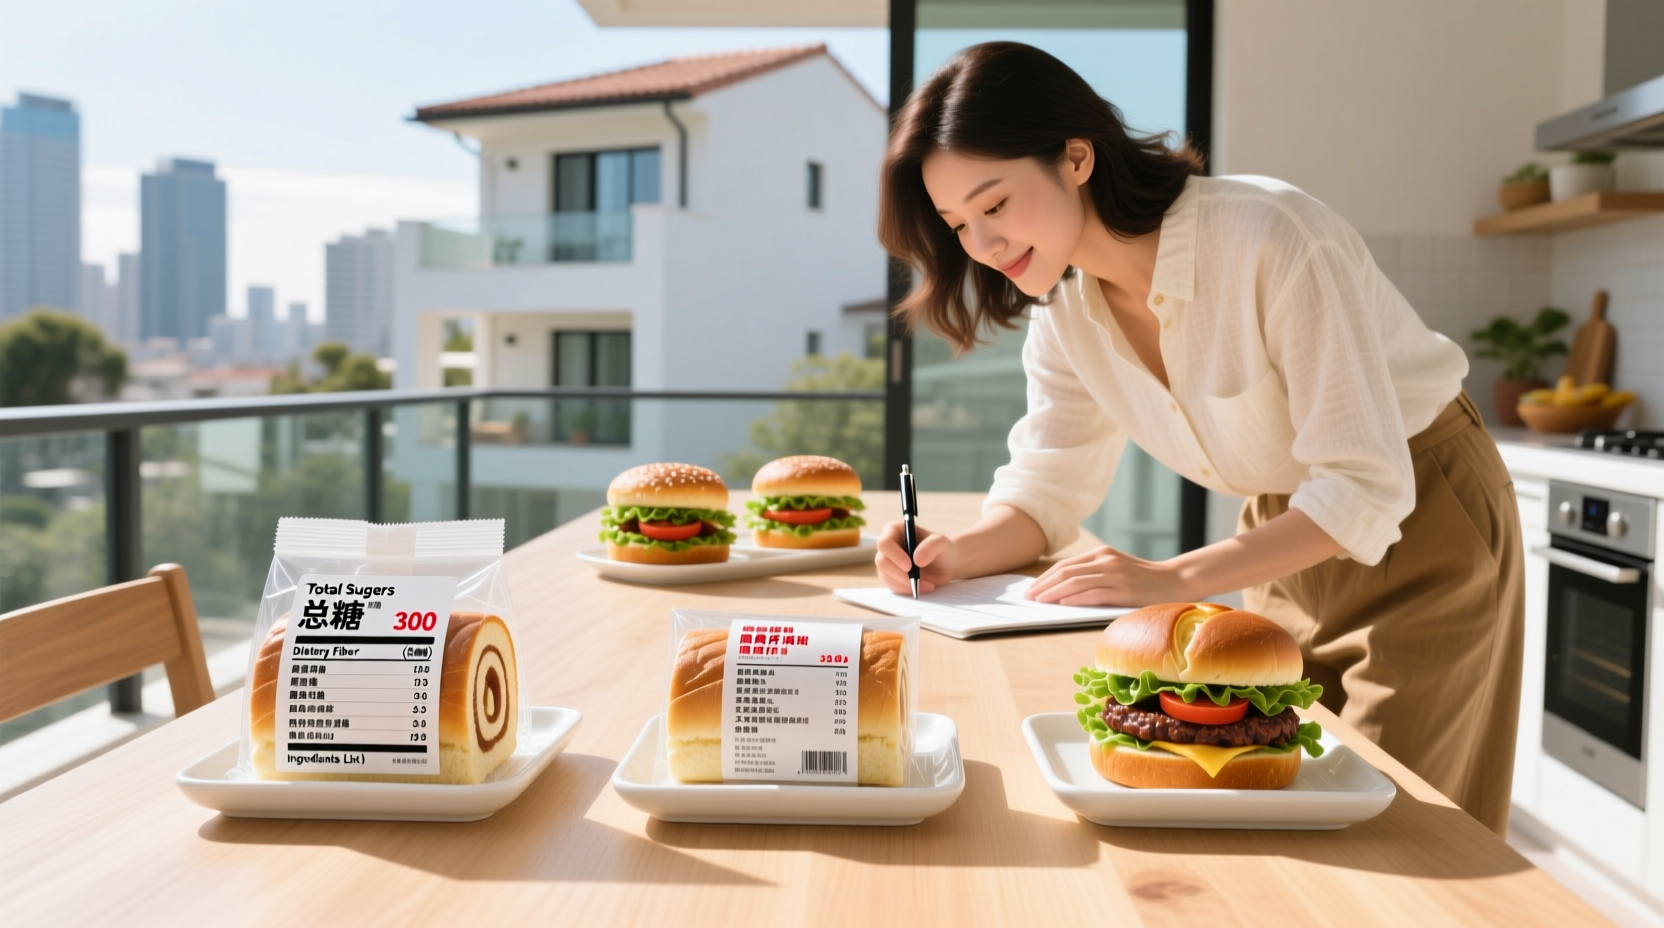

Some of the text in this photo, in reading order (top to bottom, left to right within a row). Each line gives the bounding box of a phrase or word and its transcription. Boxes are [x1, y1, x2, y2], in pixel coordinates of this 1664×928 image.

[306, 583, 395, 599] Total Sugers
[298, 599, 365, 631] 总糖
[393, 611, 438, 631] 300
